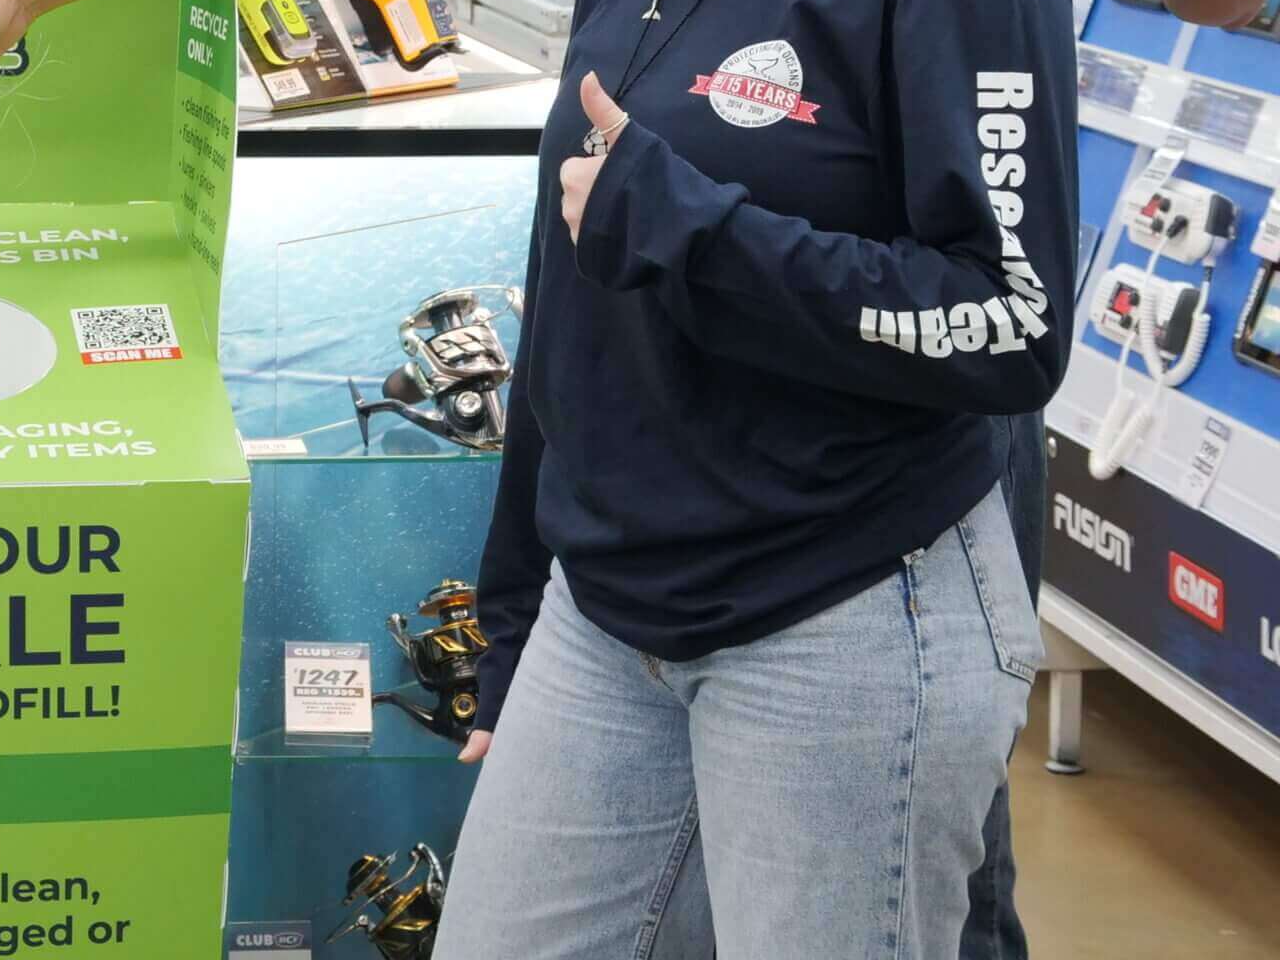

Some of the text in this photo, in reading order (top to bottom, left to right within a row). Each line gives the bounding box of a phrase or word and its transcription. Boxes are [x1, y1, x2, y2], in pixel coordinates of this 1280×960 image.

[189, 5, 228, 41] RECYCLE
[728, 78, 741, 93] 15
[746, 79, 797, 109] YEARS
[33, 247, 99, 262] BIN
[860, 296, 1026, 358] Team
[90, 347, 173, 363] SCAN ME
[27, 441, 157, 458] ITEMS
[1053, 492, 1132, 573] FUSION
[1174, 564, 1218, 619] GME
[88, 919, 130, 944] or
[236, 933, 274, 946] CLUB
